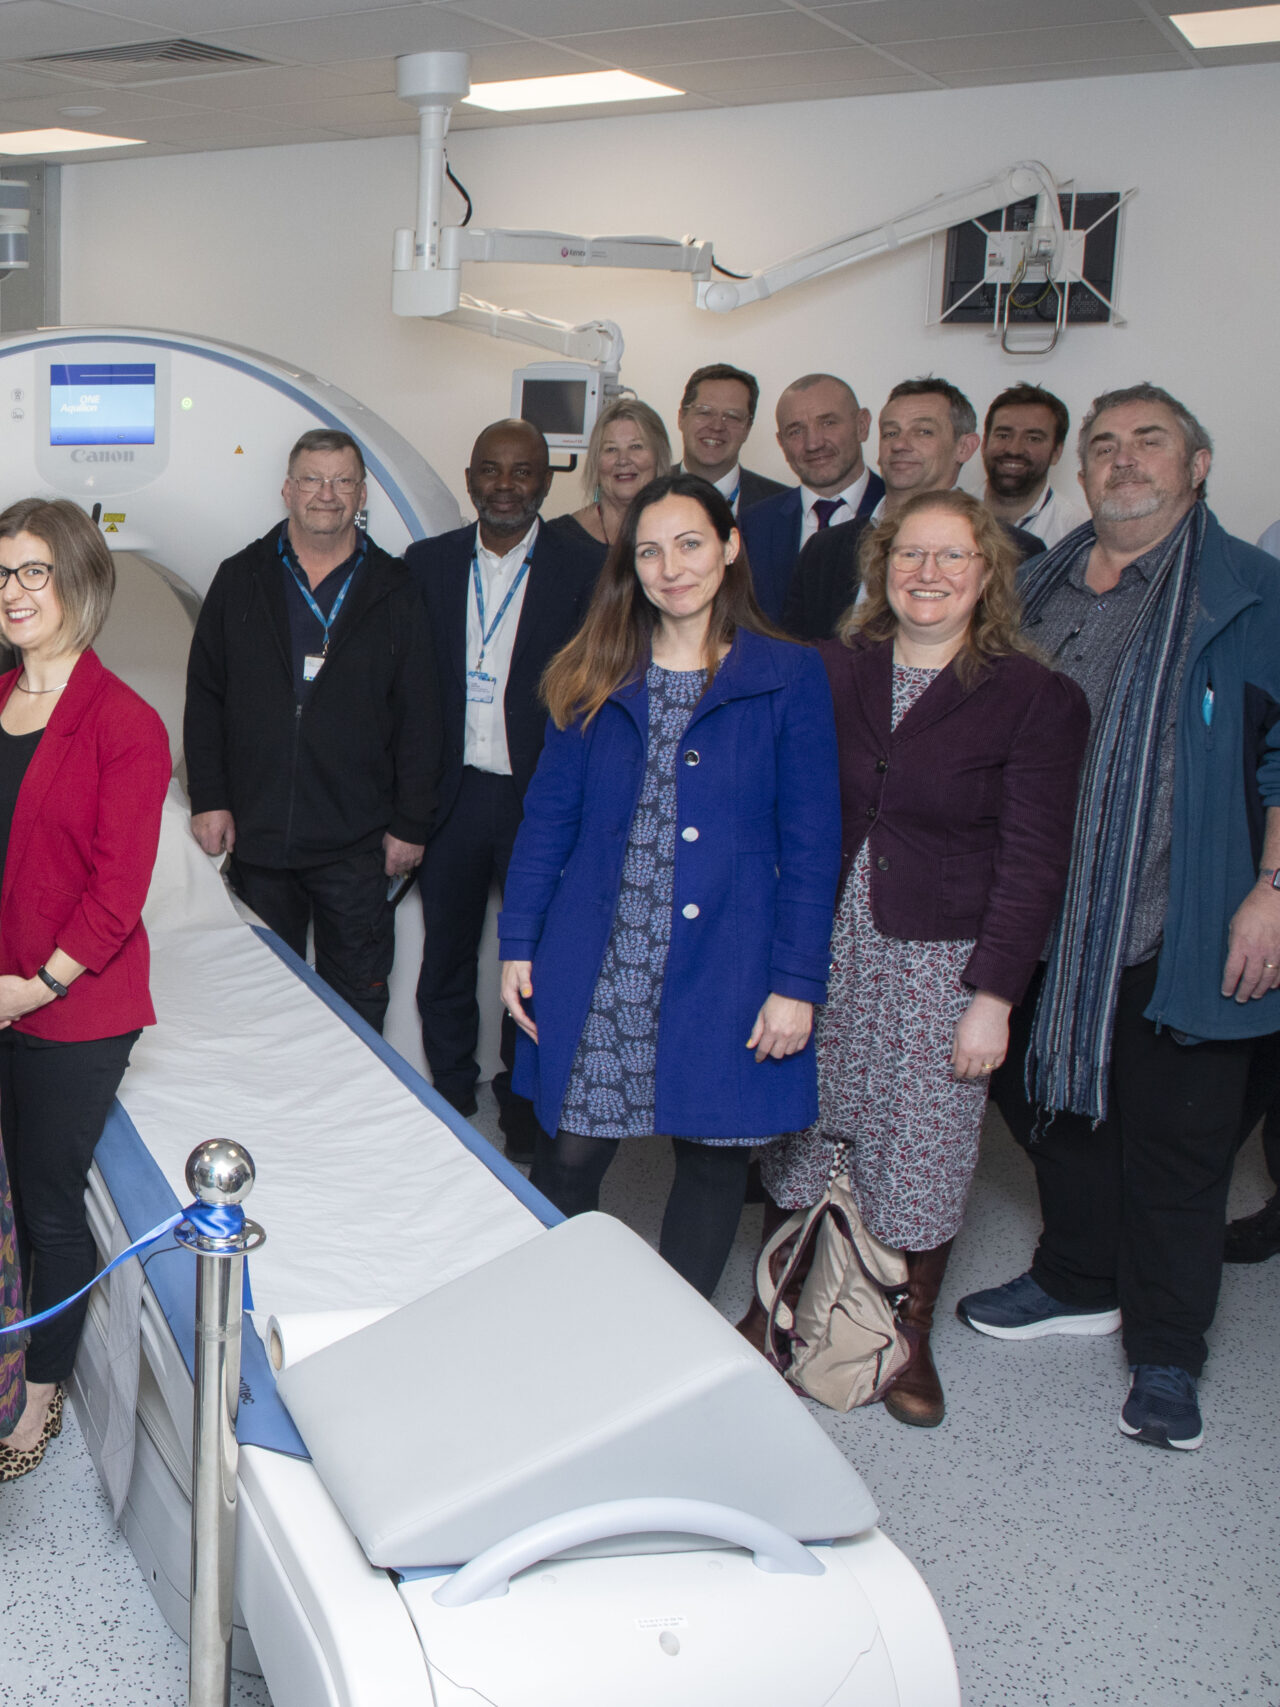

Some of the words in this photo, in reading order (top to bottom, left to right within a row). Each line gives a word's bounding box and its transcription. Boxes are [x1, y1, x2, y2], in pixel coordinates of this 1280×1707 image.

[80, 394, 100, 403] ONE
[60, 403, 98, 413] Aquilion
[70, 448, 135, 463] Canon
